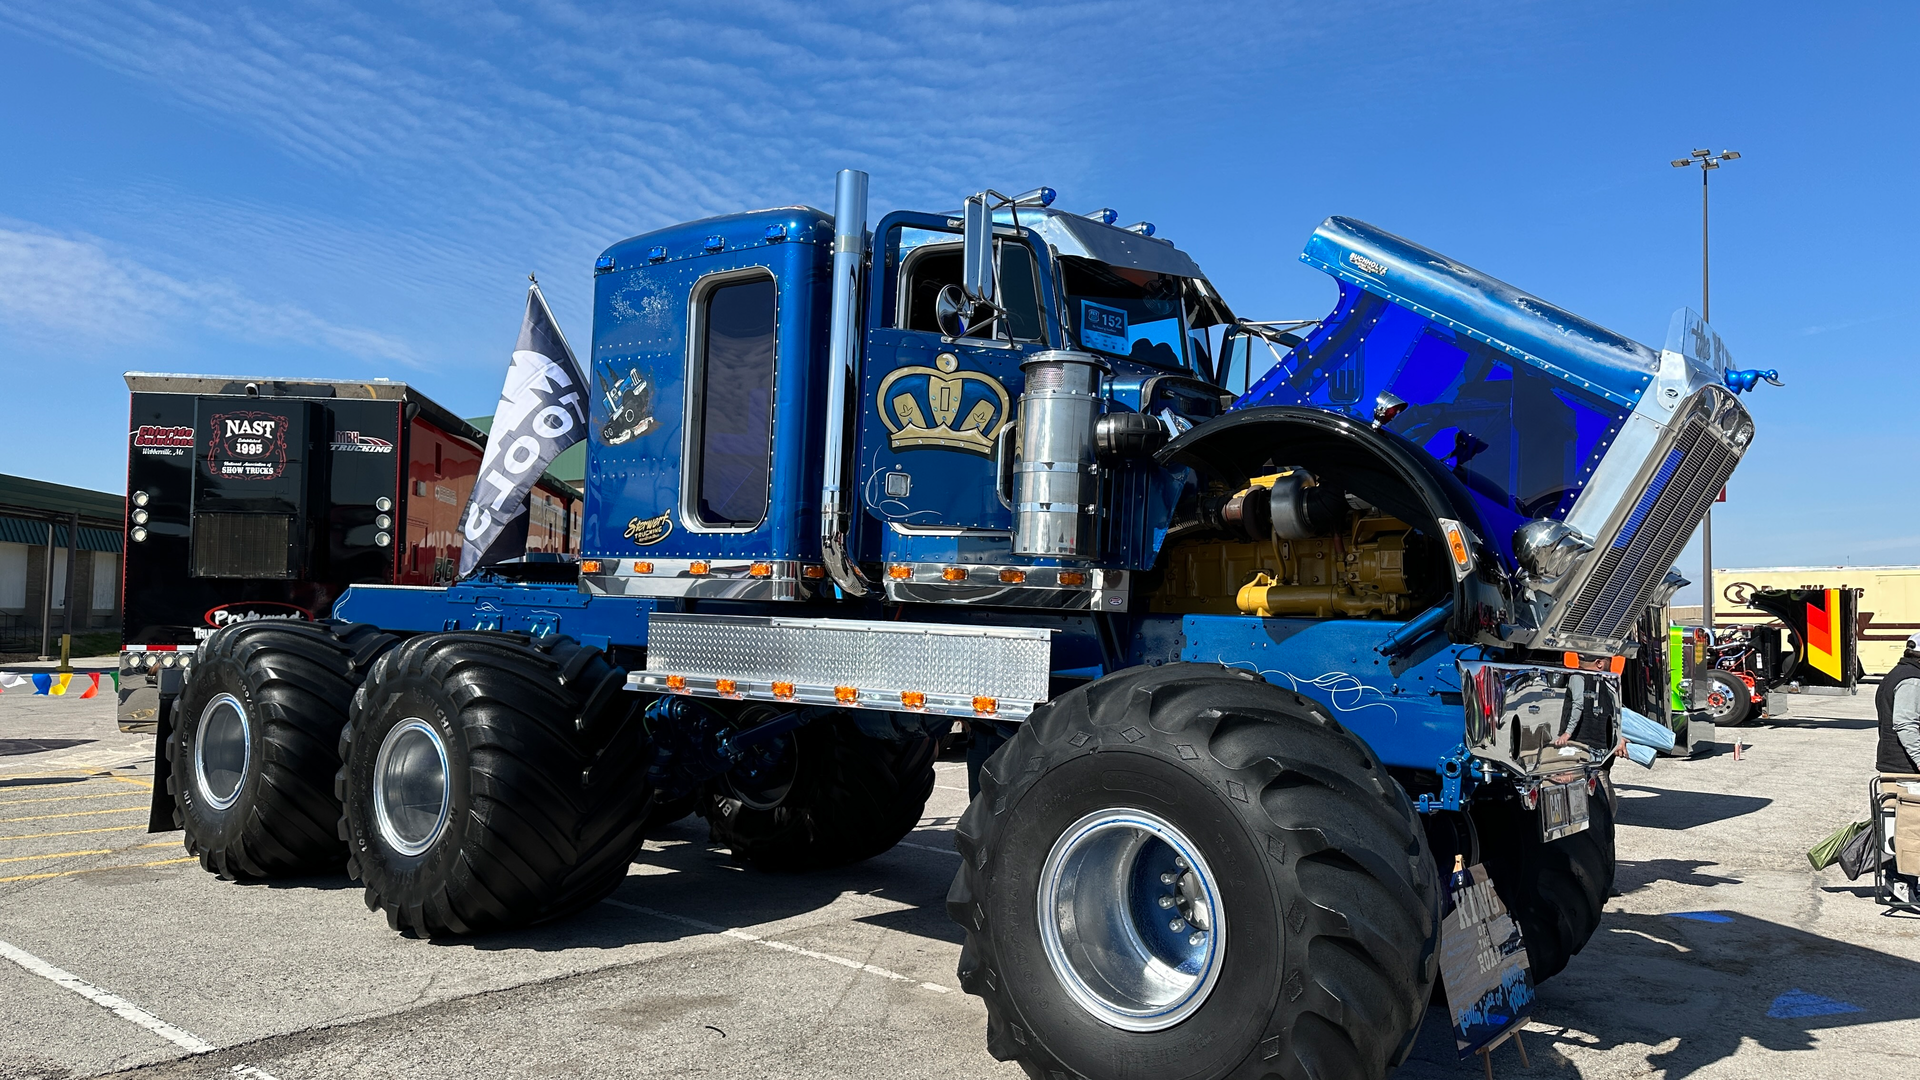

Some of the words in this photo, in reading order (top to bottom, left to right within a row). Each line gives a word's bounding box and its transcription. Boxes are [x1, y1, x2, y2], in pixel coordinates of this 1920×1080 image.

[1102, 314, 1122, 329] 152
[139, 426, 193, 437] Chloride
[225, 420, 275, 438] NAST
[135, 436, 194, 446] Solutions
[336, 431, 359, 444] MBH
[236, 443, 262, 454] 1995
[330, 444, 392, 453] TRUCKING
[222, 466, 244, 474] SHOW
[245, 467, 274, 475] TRUCKS
[635, 526, 662, 538] TRUCKING
[1451, 878, 1500, 930] KING
[1477, 922, 1489, 937] OF
[1477, 935, 1492, 950] THE
[1477, 945, 1501, 975] ROAD
